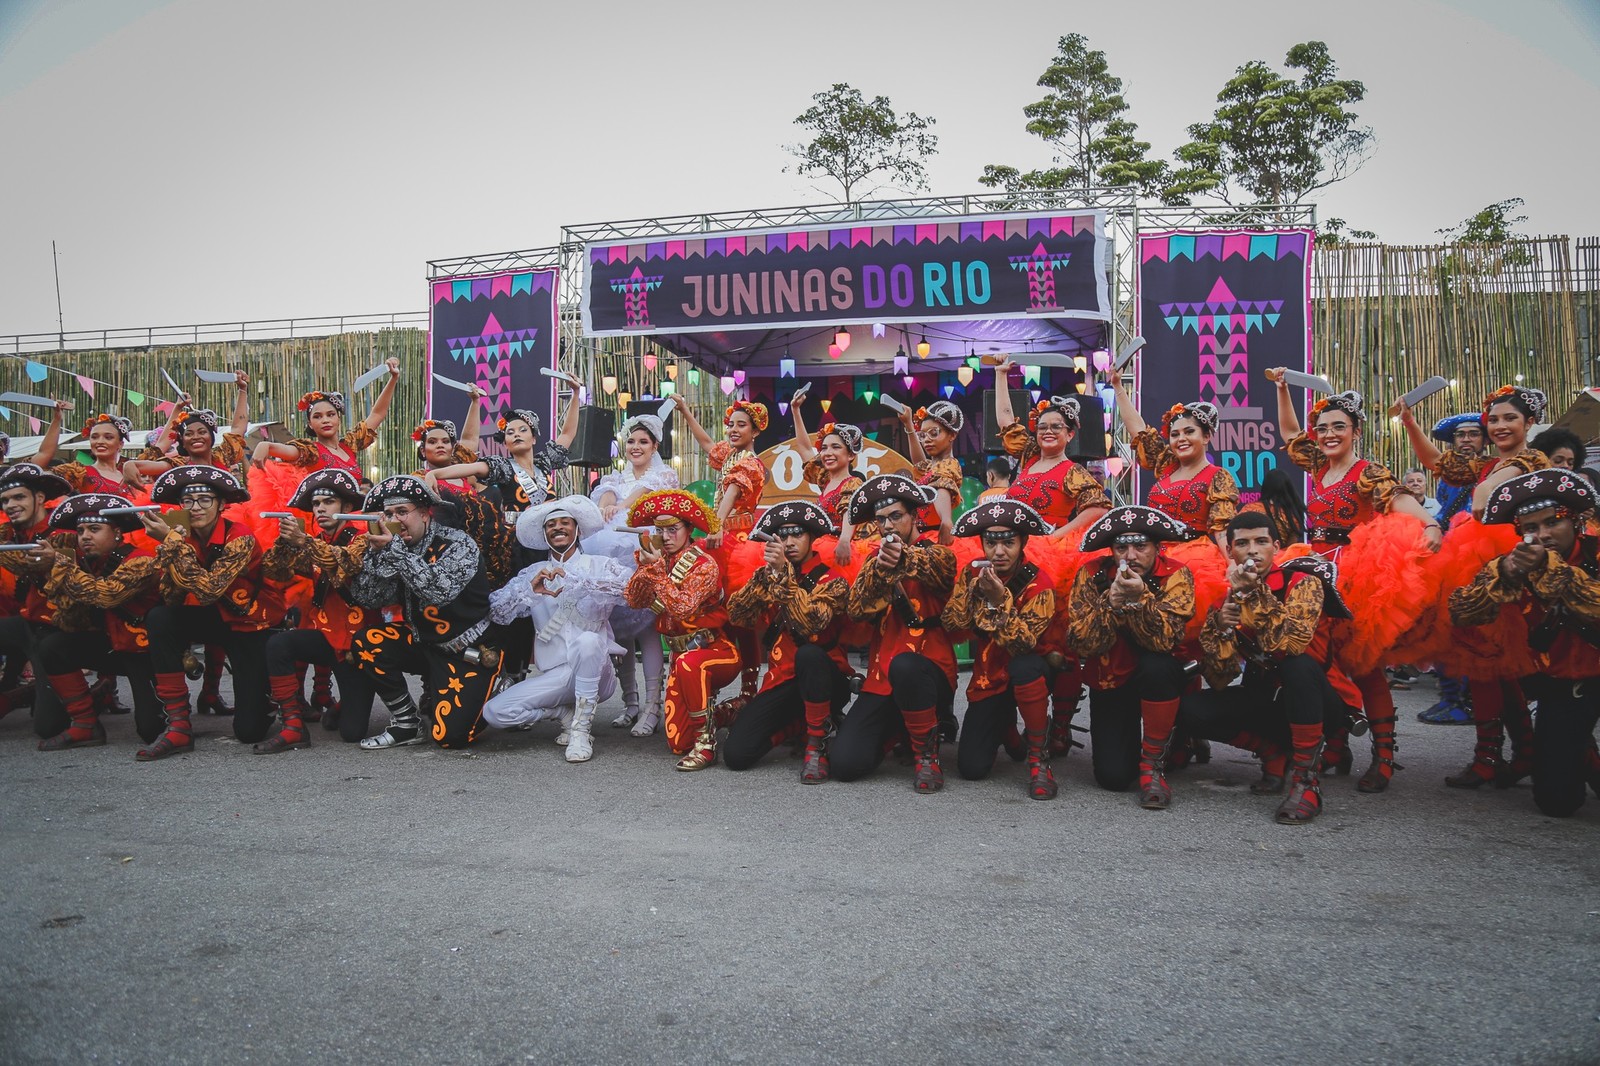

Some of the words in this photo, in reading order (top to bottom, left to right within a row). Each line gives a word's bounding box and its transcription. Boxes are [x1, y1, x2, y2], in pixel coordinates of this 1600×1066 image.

[681, 266, 854, 318] JUNINAS
[862, 263, 915, 309] DO
[923, 260, 991, 307] RIO
[1206, 421, 1276, 451] NINAS
